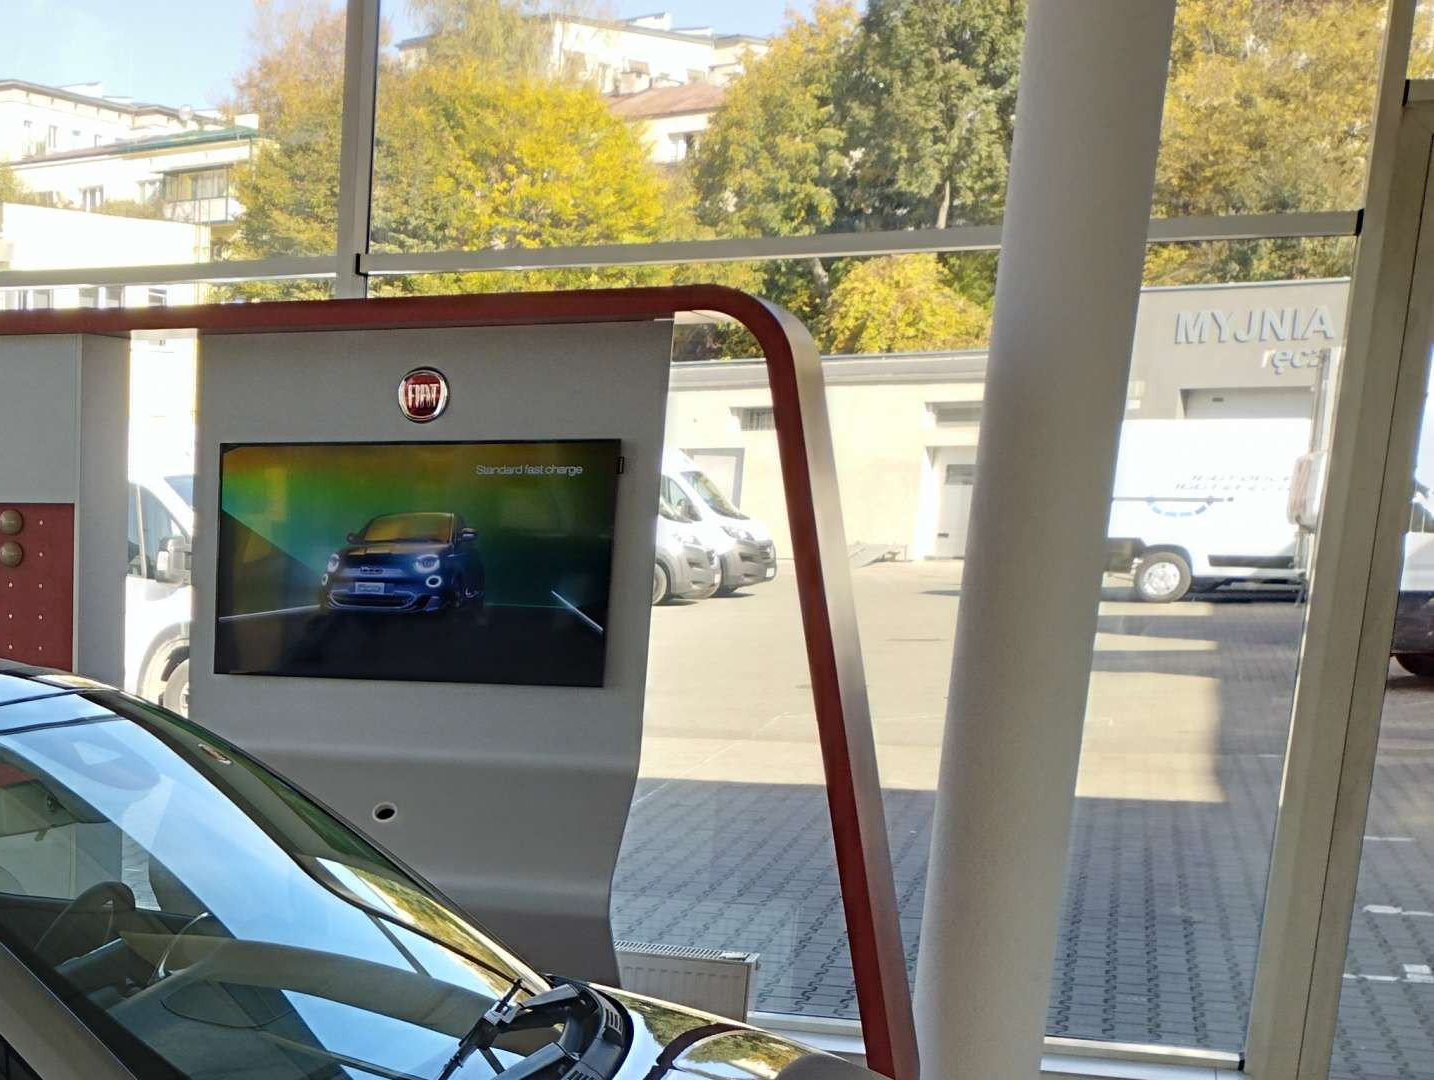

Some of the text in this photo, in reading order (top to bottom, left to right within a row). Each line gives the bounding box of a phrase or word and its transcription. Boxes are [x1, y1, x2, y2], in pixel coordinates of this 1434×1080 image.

[1174, 305, 1336, 345] MYJNIA
[408, 383, 440, 408] FIAT
[475, 464, 583, 477] Standard fast charge
